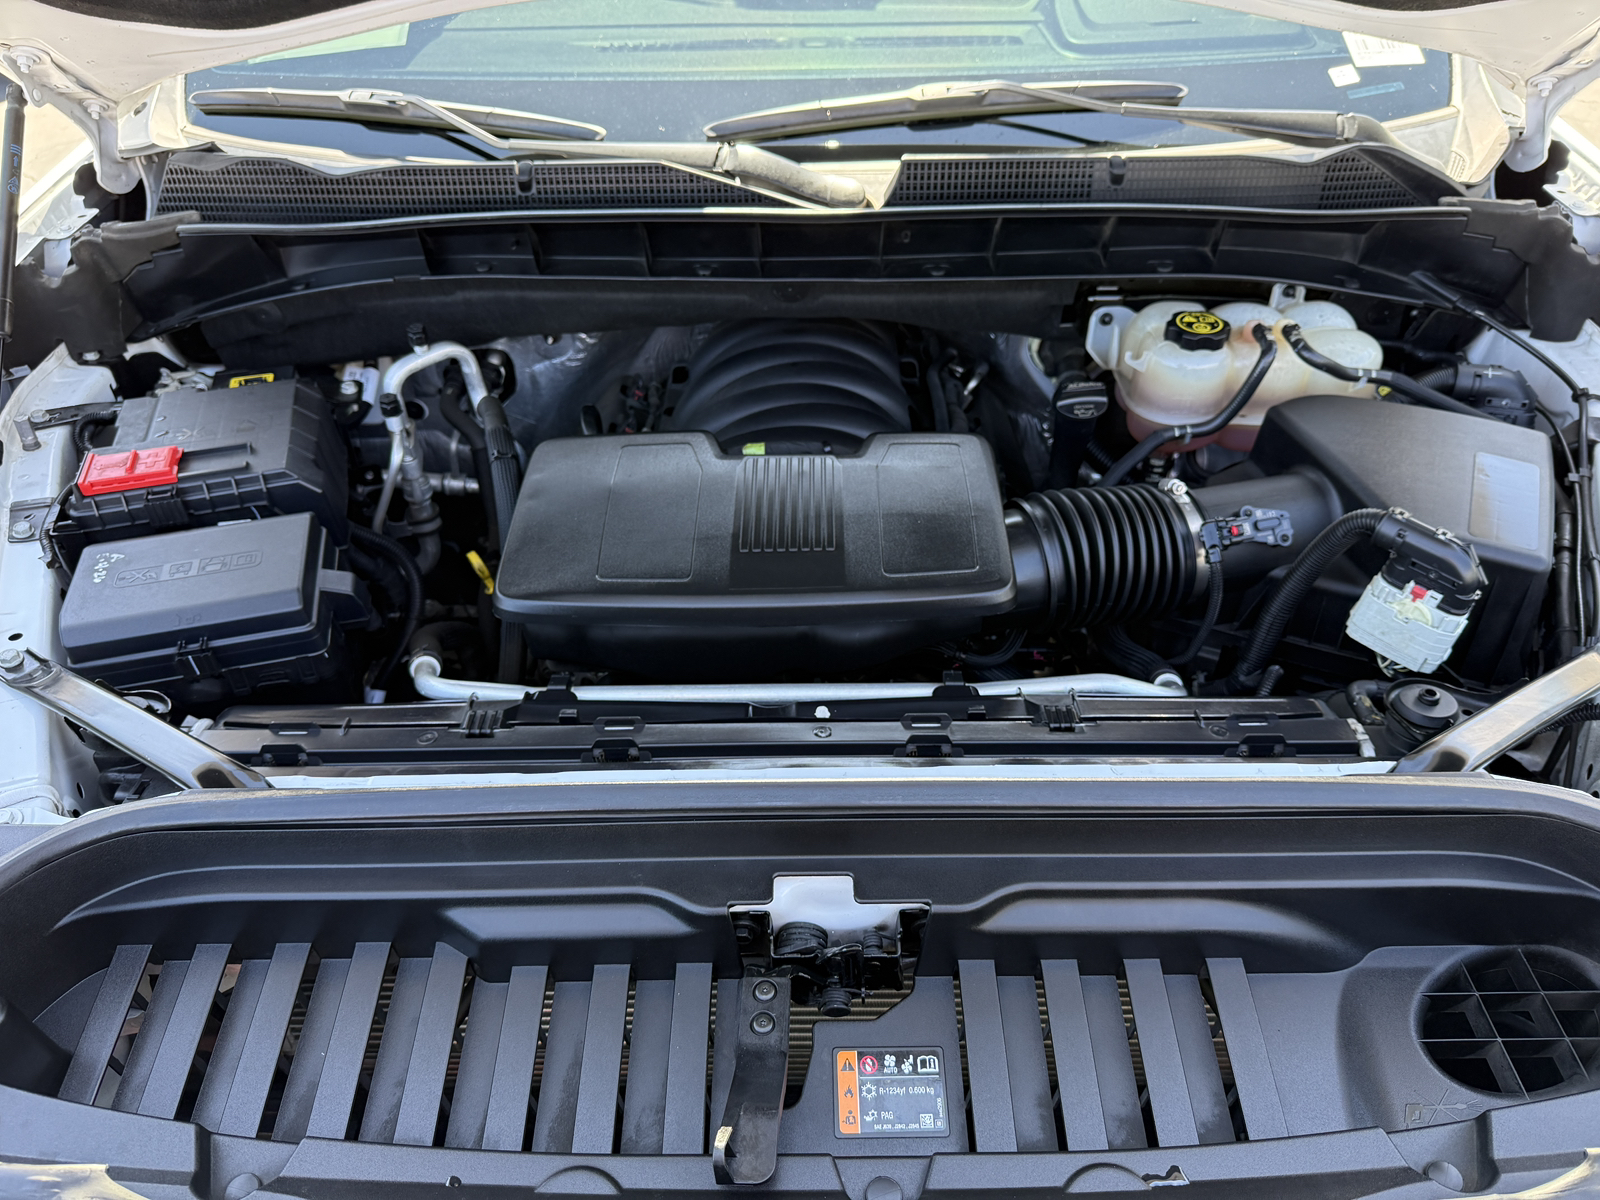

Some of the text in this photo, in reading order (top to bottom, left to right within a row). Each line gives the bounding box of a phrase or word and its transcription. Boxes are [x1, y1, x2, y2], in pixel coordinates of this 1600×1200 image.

[883, 1066, 898, 1074] AUTO
[879, 1086, 934, 1096] R-1234yf 0.600 kg
[881, 1111, 894, 1120] PAG
